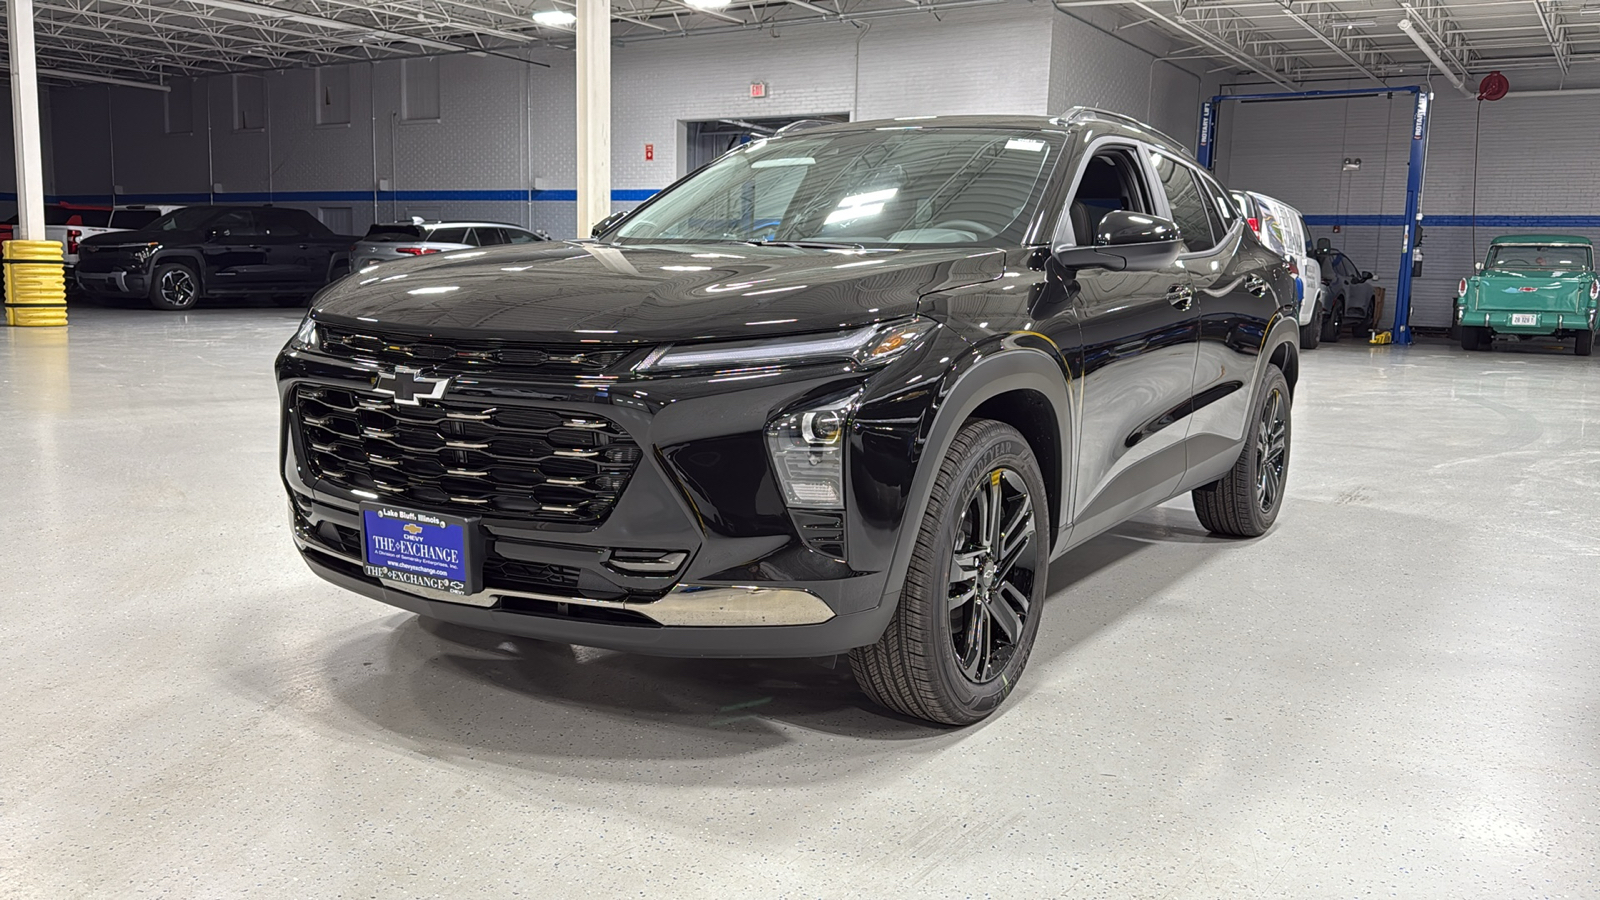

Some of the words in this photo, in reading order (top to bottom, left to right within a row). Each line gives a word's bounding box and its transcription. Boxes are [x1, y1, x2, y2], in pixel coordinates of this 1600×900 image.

[383, 508, 398, 518] Lake
[400, 511, 417, 520] Bluff,
[418, 514, 440, 524] Illinois
[403, 534, 424, 542] CHEVY
[373, 536, 396, 552] THE
[400, 540, 458, 563] EXCHANGE
[387, 560, 448, 576] www.chevyexchange.com
[366, 566, 384, 577] THE
[392, 571, 445, 589] EXCHANGE
